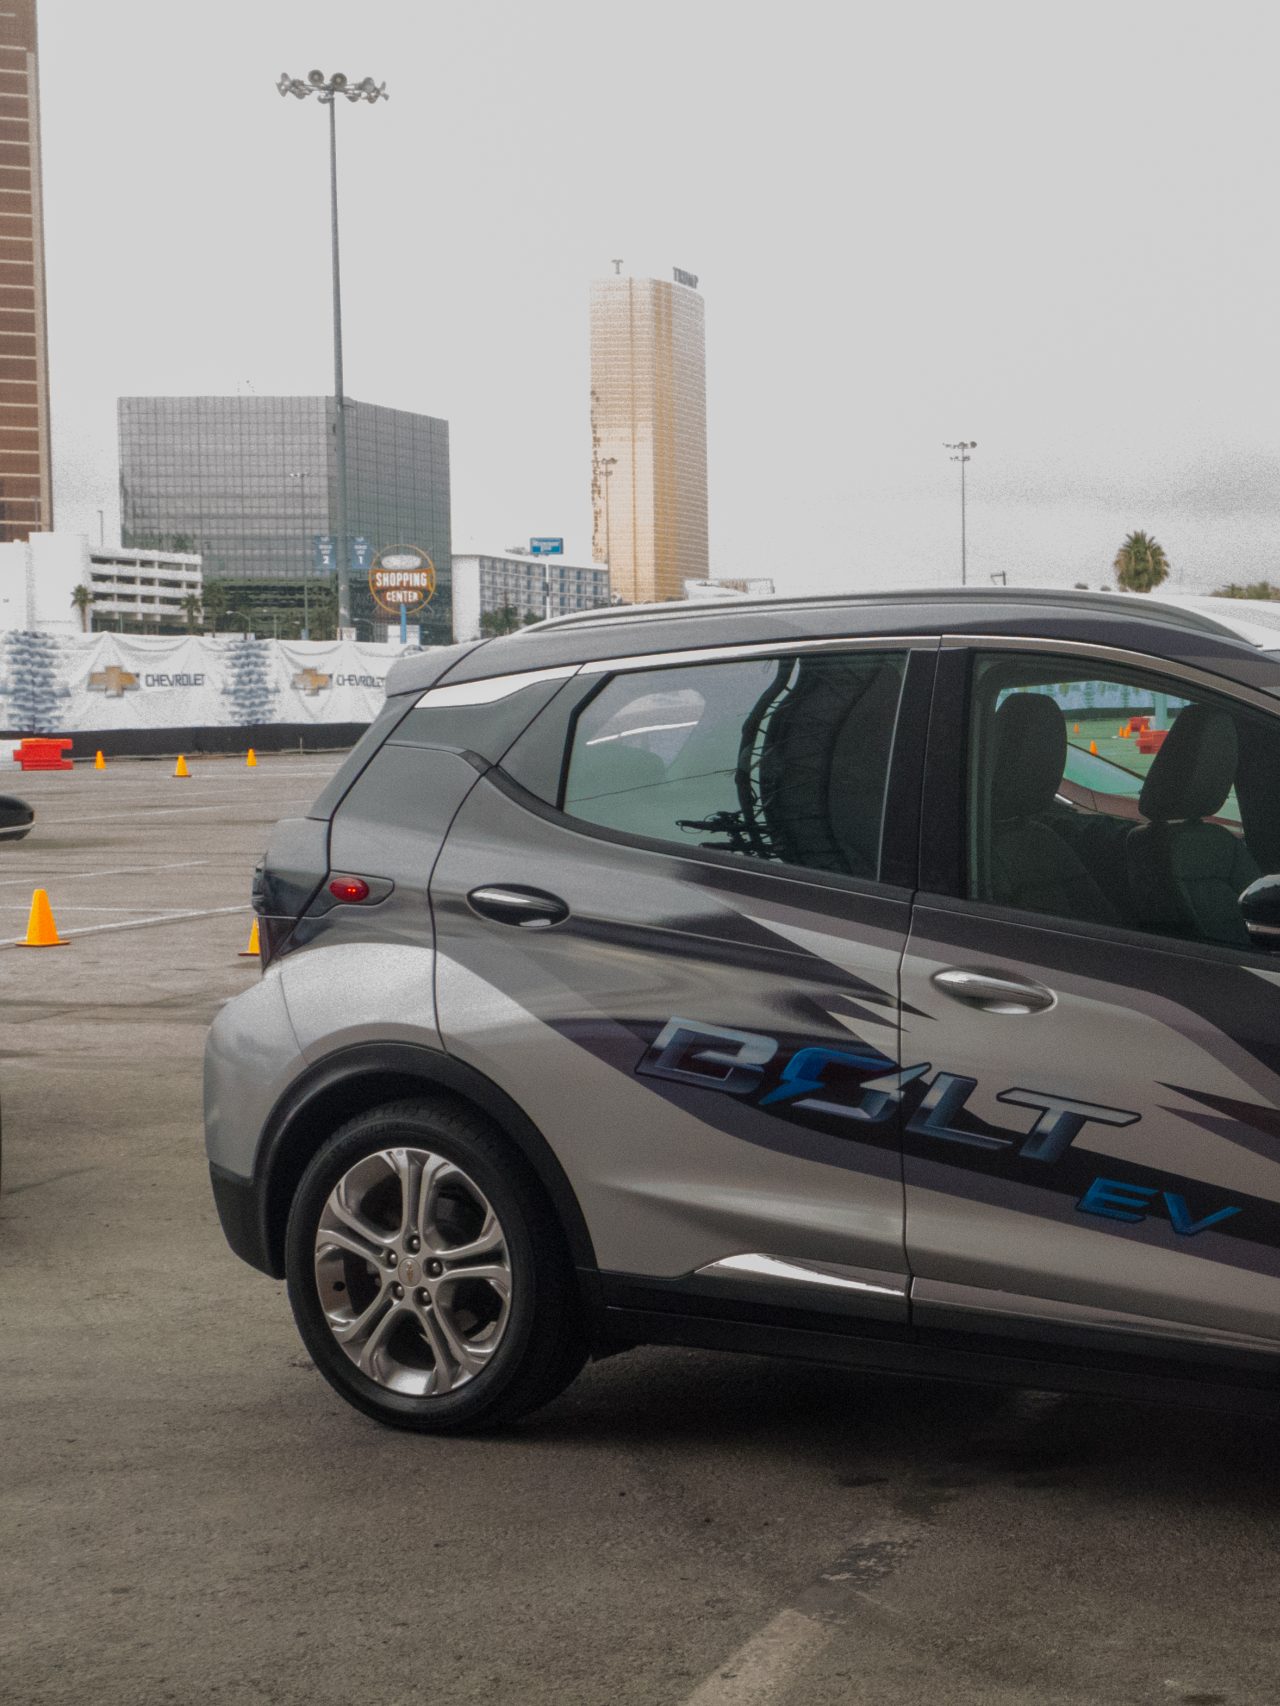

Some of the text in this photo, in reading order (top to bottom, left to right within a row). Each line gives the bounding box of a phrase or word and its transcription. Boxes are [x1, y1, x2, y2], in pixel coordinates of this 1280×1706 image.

[375, 572, 428, 588] SHOPPING
[386, 591, 419, 603] CENTER
[145, 673, 205, 687] CHEVROLET
[633, 1016, 1142, 1163] BOLT
[1075, 1176, 1243, 1236] EV
